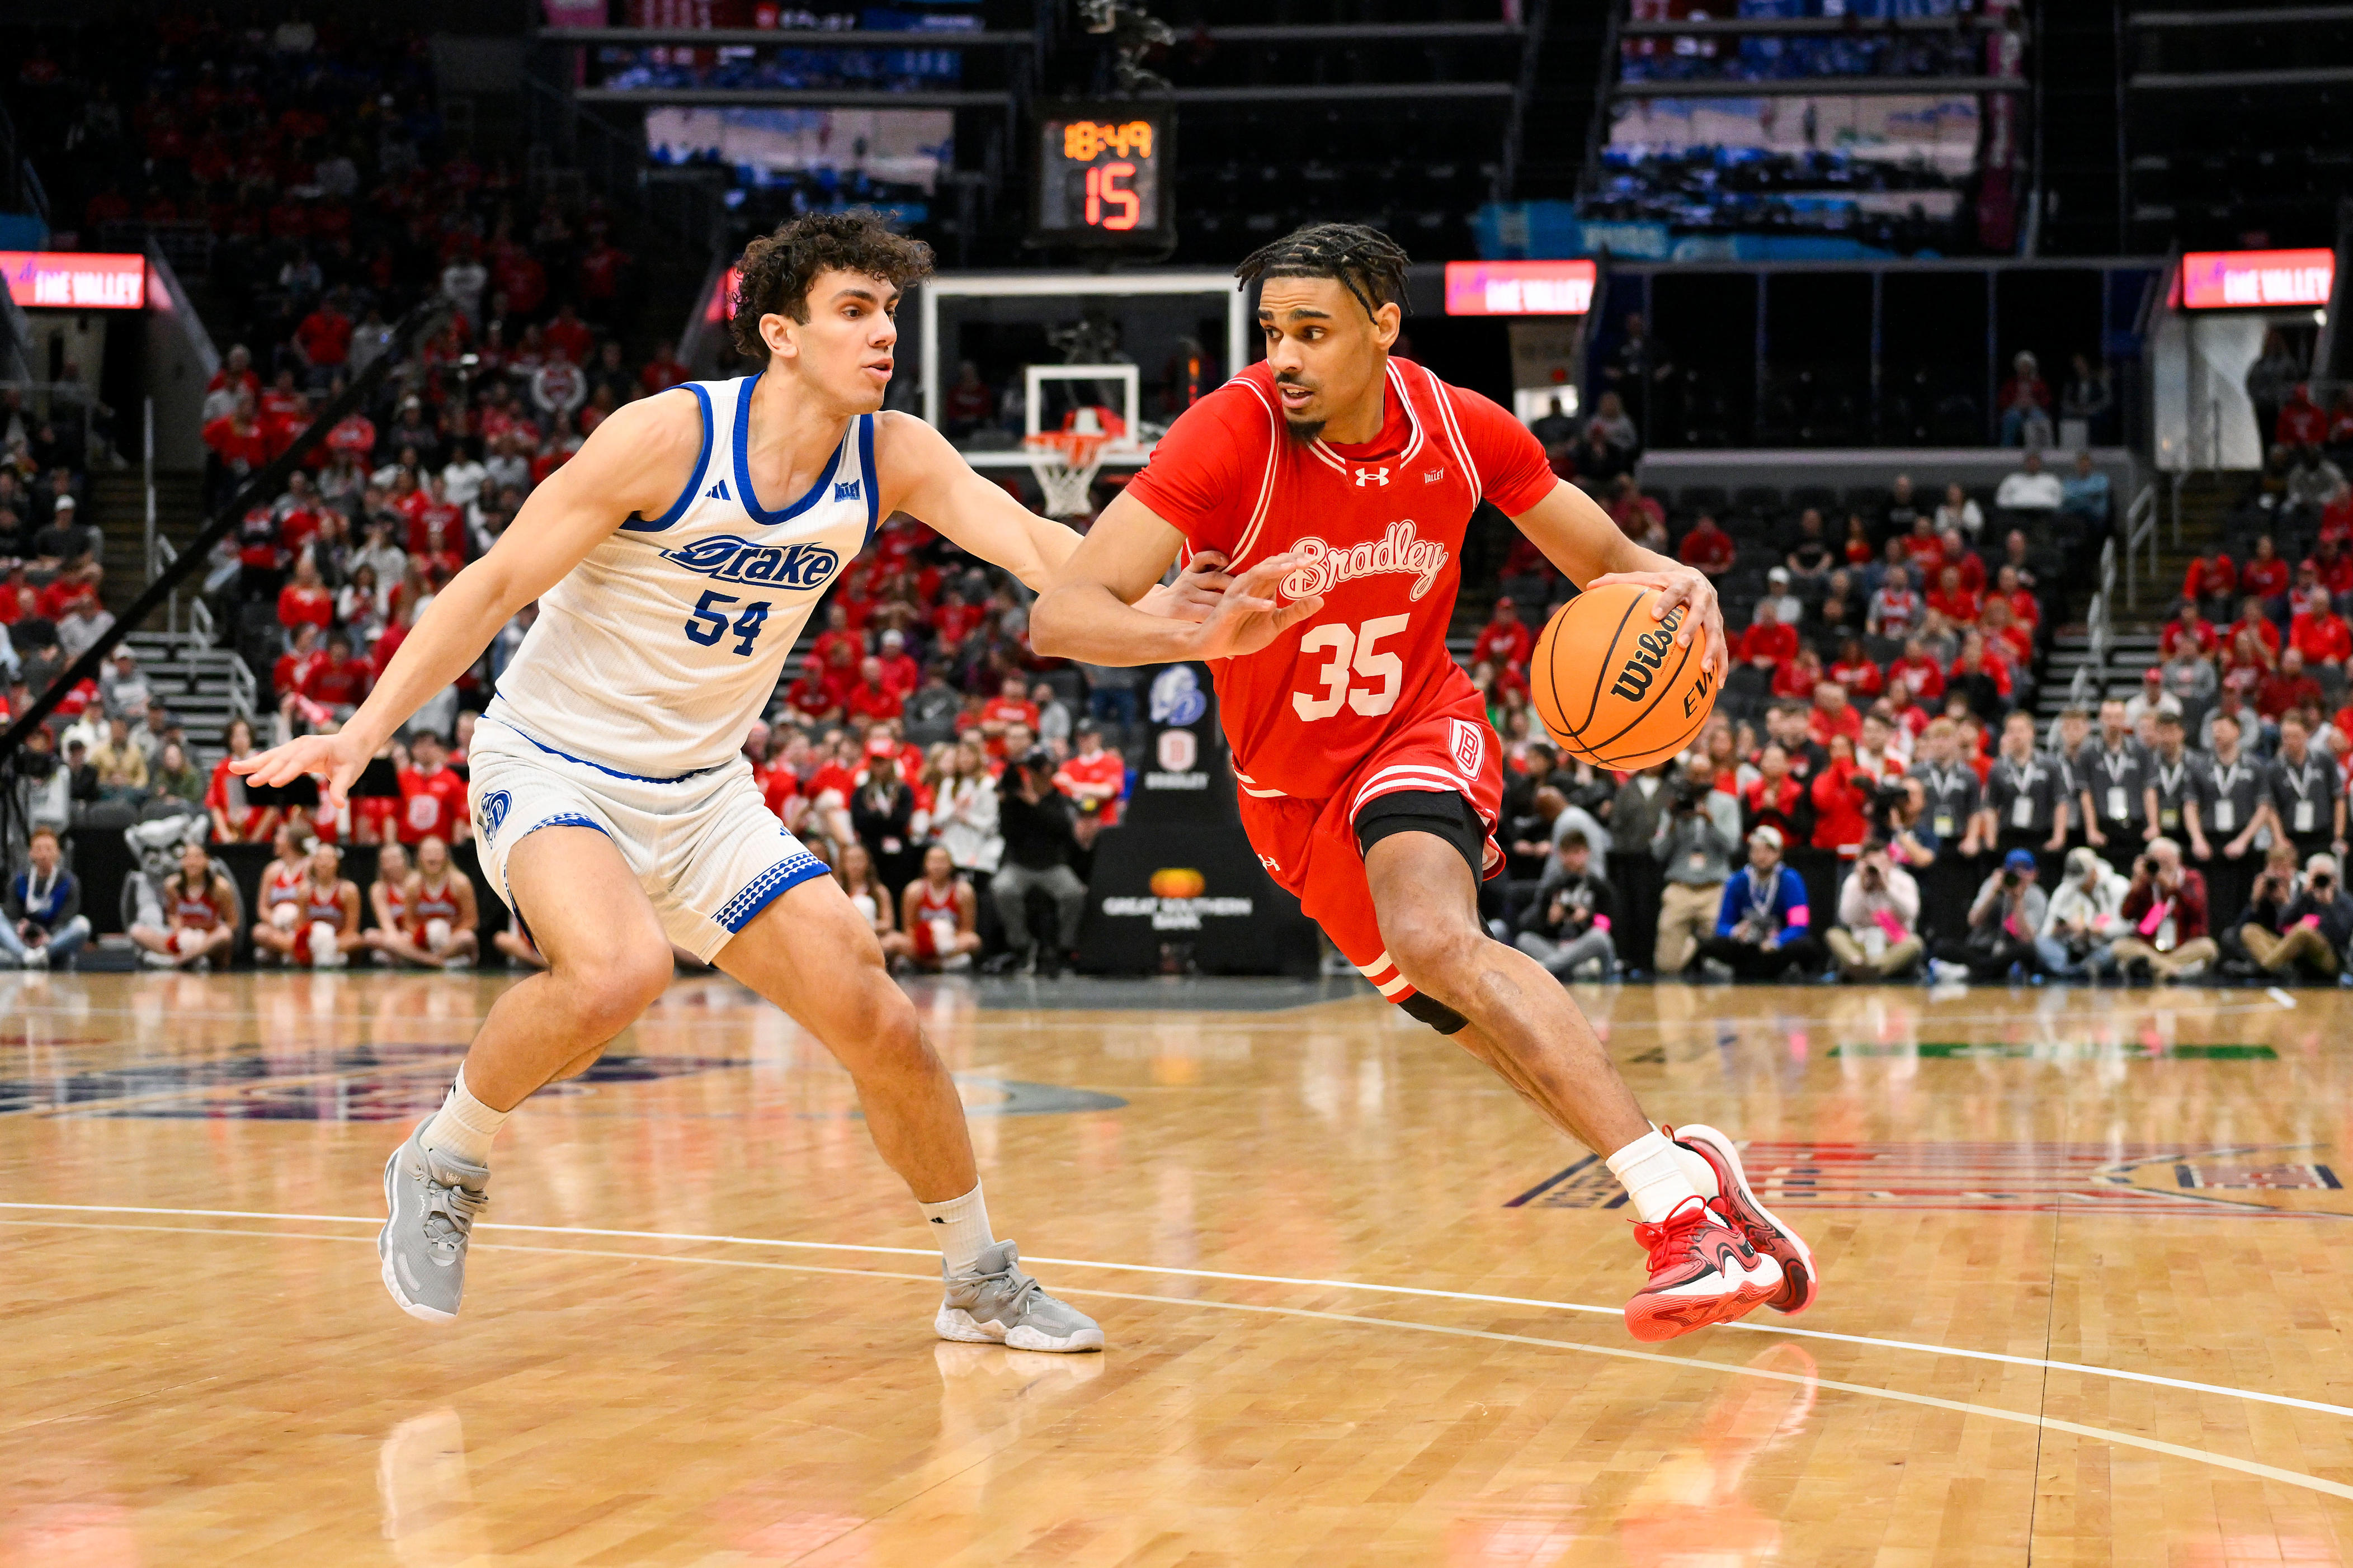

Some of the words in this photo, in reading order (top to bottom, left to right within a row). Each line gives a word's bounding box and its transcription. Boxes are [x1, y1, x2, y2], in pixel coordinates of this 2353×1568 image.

[1064, 121, 1152, 161] 18:49
[1085, 163, 1140, 230] 15
[1424, 467, 1444, 484] VALLEY
[658, 535, 839, 591] Drake
[1279, 518, 1449, 602] Bradley
[684, 589, 772, 657] 54
[1292, 612, 1411, 722] 35
[1610, 606, 1684, 702] Wilson
[1682, 663, 1715, 719] EV
[1456, 724, 1479, 771] B
